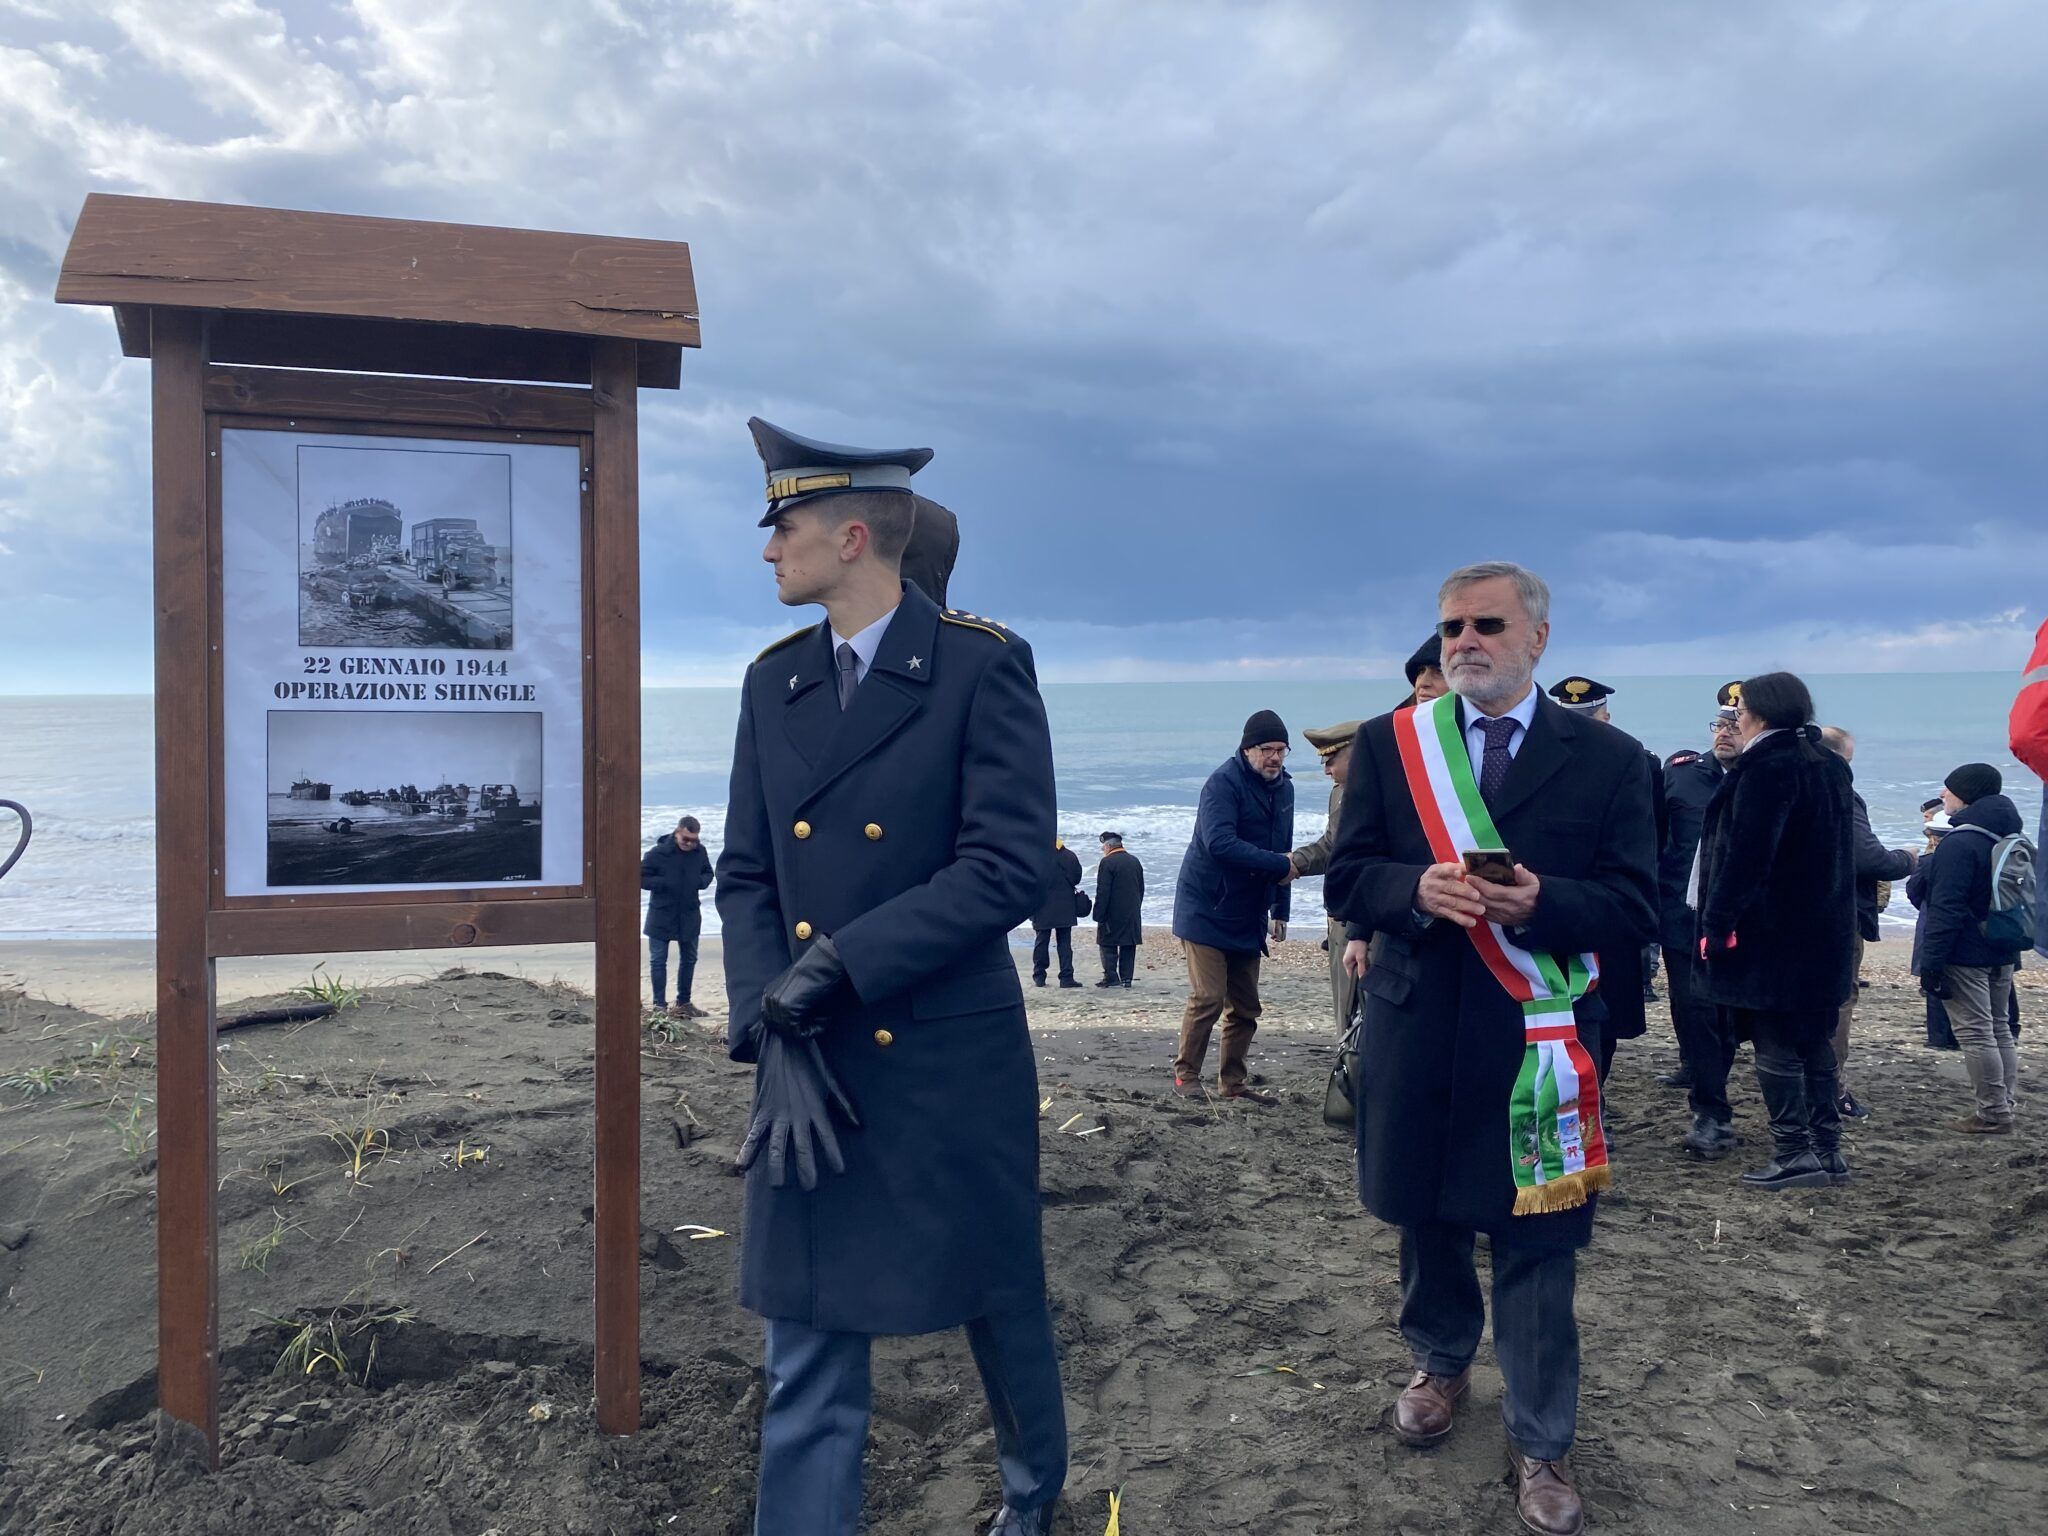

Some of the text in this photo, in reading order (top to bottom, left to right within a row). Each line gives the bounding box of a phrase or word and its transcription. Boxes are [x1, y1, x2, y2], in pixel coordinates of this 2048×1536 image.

[303, 656, 509, 676] 22 GENNAIO 1944
[274, 681, 536, 701] OPERAZIONE SHINGLE
